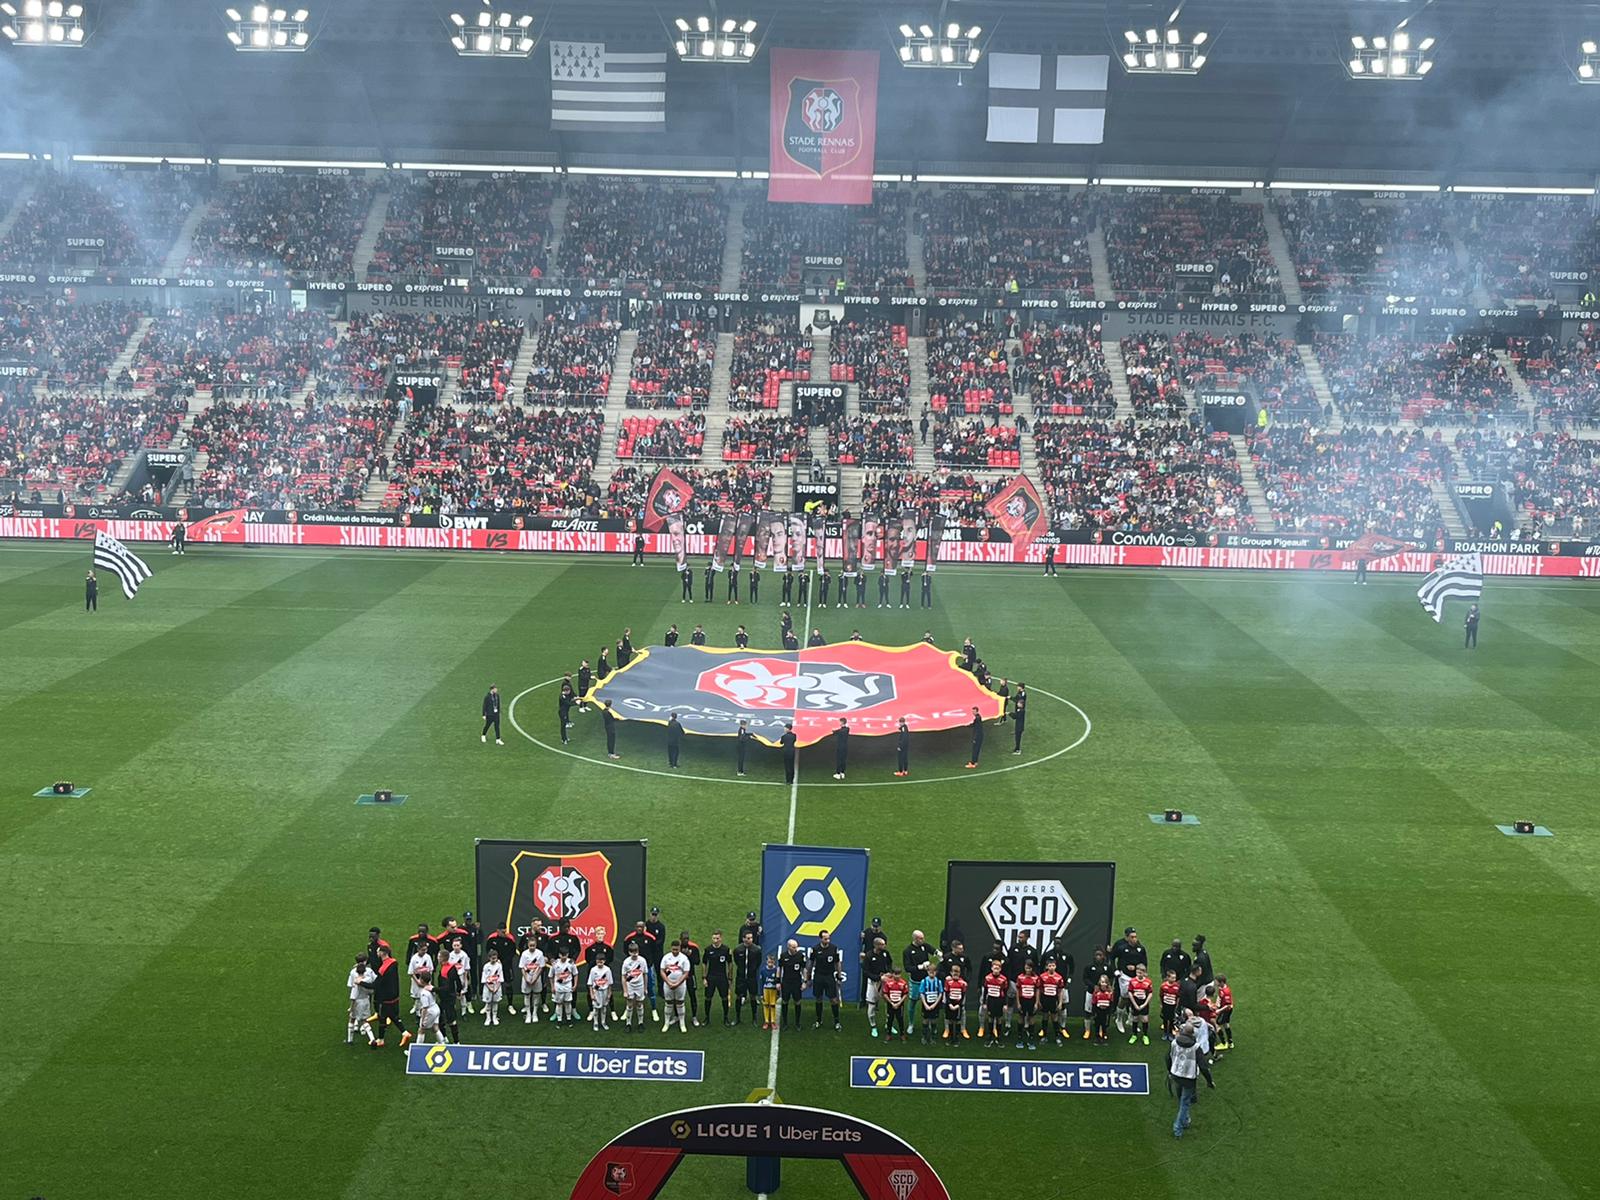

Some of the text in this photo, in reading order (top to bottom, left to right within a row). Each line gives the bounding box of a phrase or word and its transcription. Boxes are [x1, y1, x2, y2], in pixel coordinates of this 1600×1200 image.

[789, 136, 855, 147] STADE RENNAIS
[318, 168, 344, 176] SUPER
[67, 238, 96, 247] SUPER
[436, 247, 465, 255] SUPER
[805, 256, 834, 265] SUPER
[1175, 264, 1205, 272] SUPER
[131, 278, 159, 286] HYPER
[235, 279, 265, 288] express
[309, 282, 338, 290] HYPER
[357, 284, 385, 292] SUPER
[413, 283, 444, 293] express
[487, 287, 516, 295] HYPER
[535, 288, 563, 297] SUPER
[592, 289, 622, 298] express
[665, 292, 694, 301] HYPER
[713, 293, 741, 302] SUPER
[371, 294, 419, 308] STADE
[770, 294, 800, 303] express
[844, 296, 872, 305] HYPER
[891, 297, 918, 306] SUPER
[948, 297, 978, 307] express
[1021, 300, 1050, 308] HYPER
[1070, 301, 1097, 309] SUPER
[1127, 301, 1158, 310] express
[1201, 303, 1230, 311] HYPER
[1250, 304, 1277, 312] SUPER
[1307, 304, 1338, 314] express
[1430, 308, 1458, 316] SUPER
[1488, 309, 1518, 318] express
[1127, 312, 1175, 325] STADE
[1179, 313, 1246, 326] RENNAIS
[1563, 311, 1592, 319] HYPER
[397, 376, 433, 387] SUPER
[797, 387, 832, 398] SUPER
[147, 453, 176, 463] SUPER
[797, 484, 828, 494] SUPER
[303, 513, 394, 525] Crédit Mutuel de Bretagne
[454, 516, 489, 530] BWT
[551, 518, 599, 533] DEL ARTE
[1241, 537, 1273, 547] Groupe
[1454, 542, 1540, 554] ROAZHON PARK
[621, 697, 758, 719] STADE
[1005, 885, 1056, 894] ANGERS
[999, 895, 1059, 926] SCO
[517, 925, 553, 938] STDE
[467, 1050, 688, 1076] LIGUE 1 Uber Eats
[910, 1063, 1132, 1089] LIGUE 1 Uber Eats
[697, 1123, 862, 1142] LIGUE 1 Uber Eats
[893, 1174, 914, 1185] SCO
